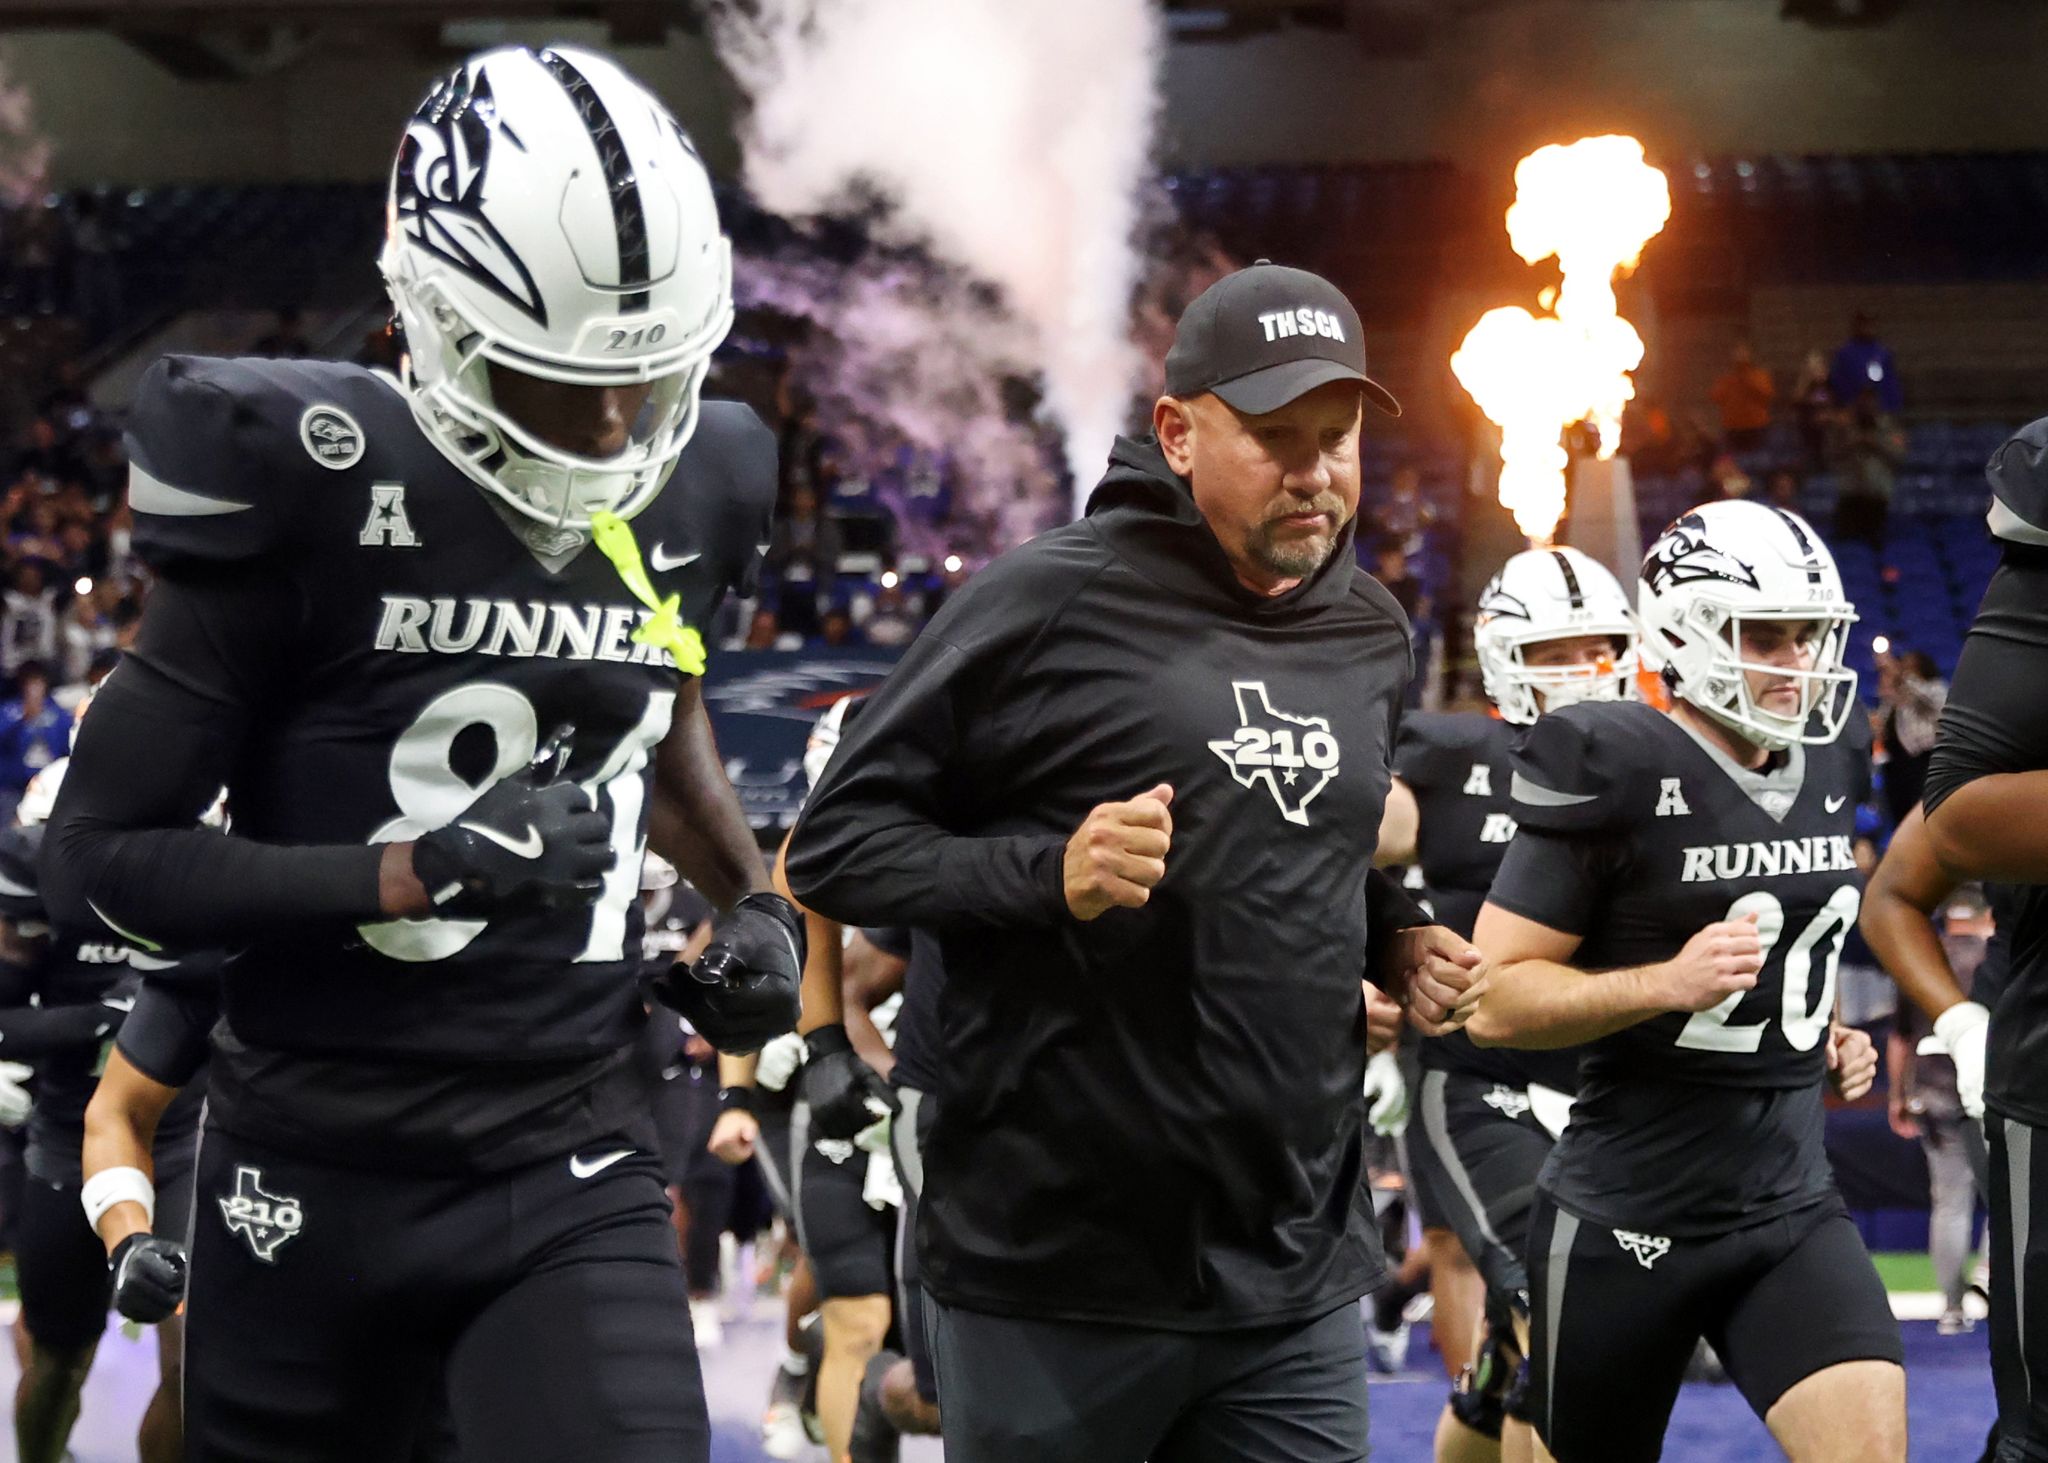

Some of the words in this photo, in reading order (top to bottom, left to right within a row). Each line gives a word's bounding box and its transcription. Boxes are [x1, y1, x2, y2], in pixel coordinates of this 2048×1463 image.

[604, 323, 666, 352] 210
[1258, 308, 1345, 343] THSCA
[359, 485, 416, 547] A
[1807, 588, 1834, 602] 210
[374, 597, 683, 668] RUNNE
[1233, 727, 1340, 770] 210
[1655, 776, 1692, 817] A
[1674, 884, 1861, 1054] 20
[229, 1197, 303, 1230] 210
